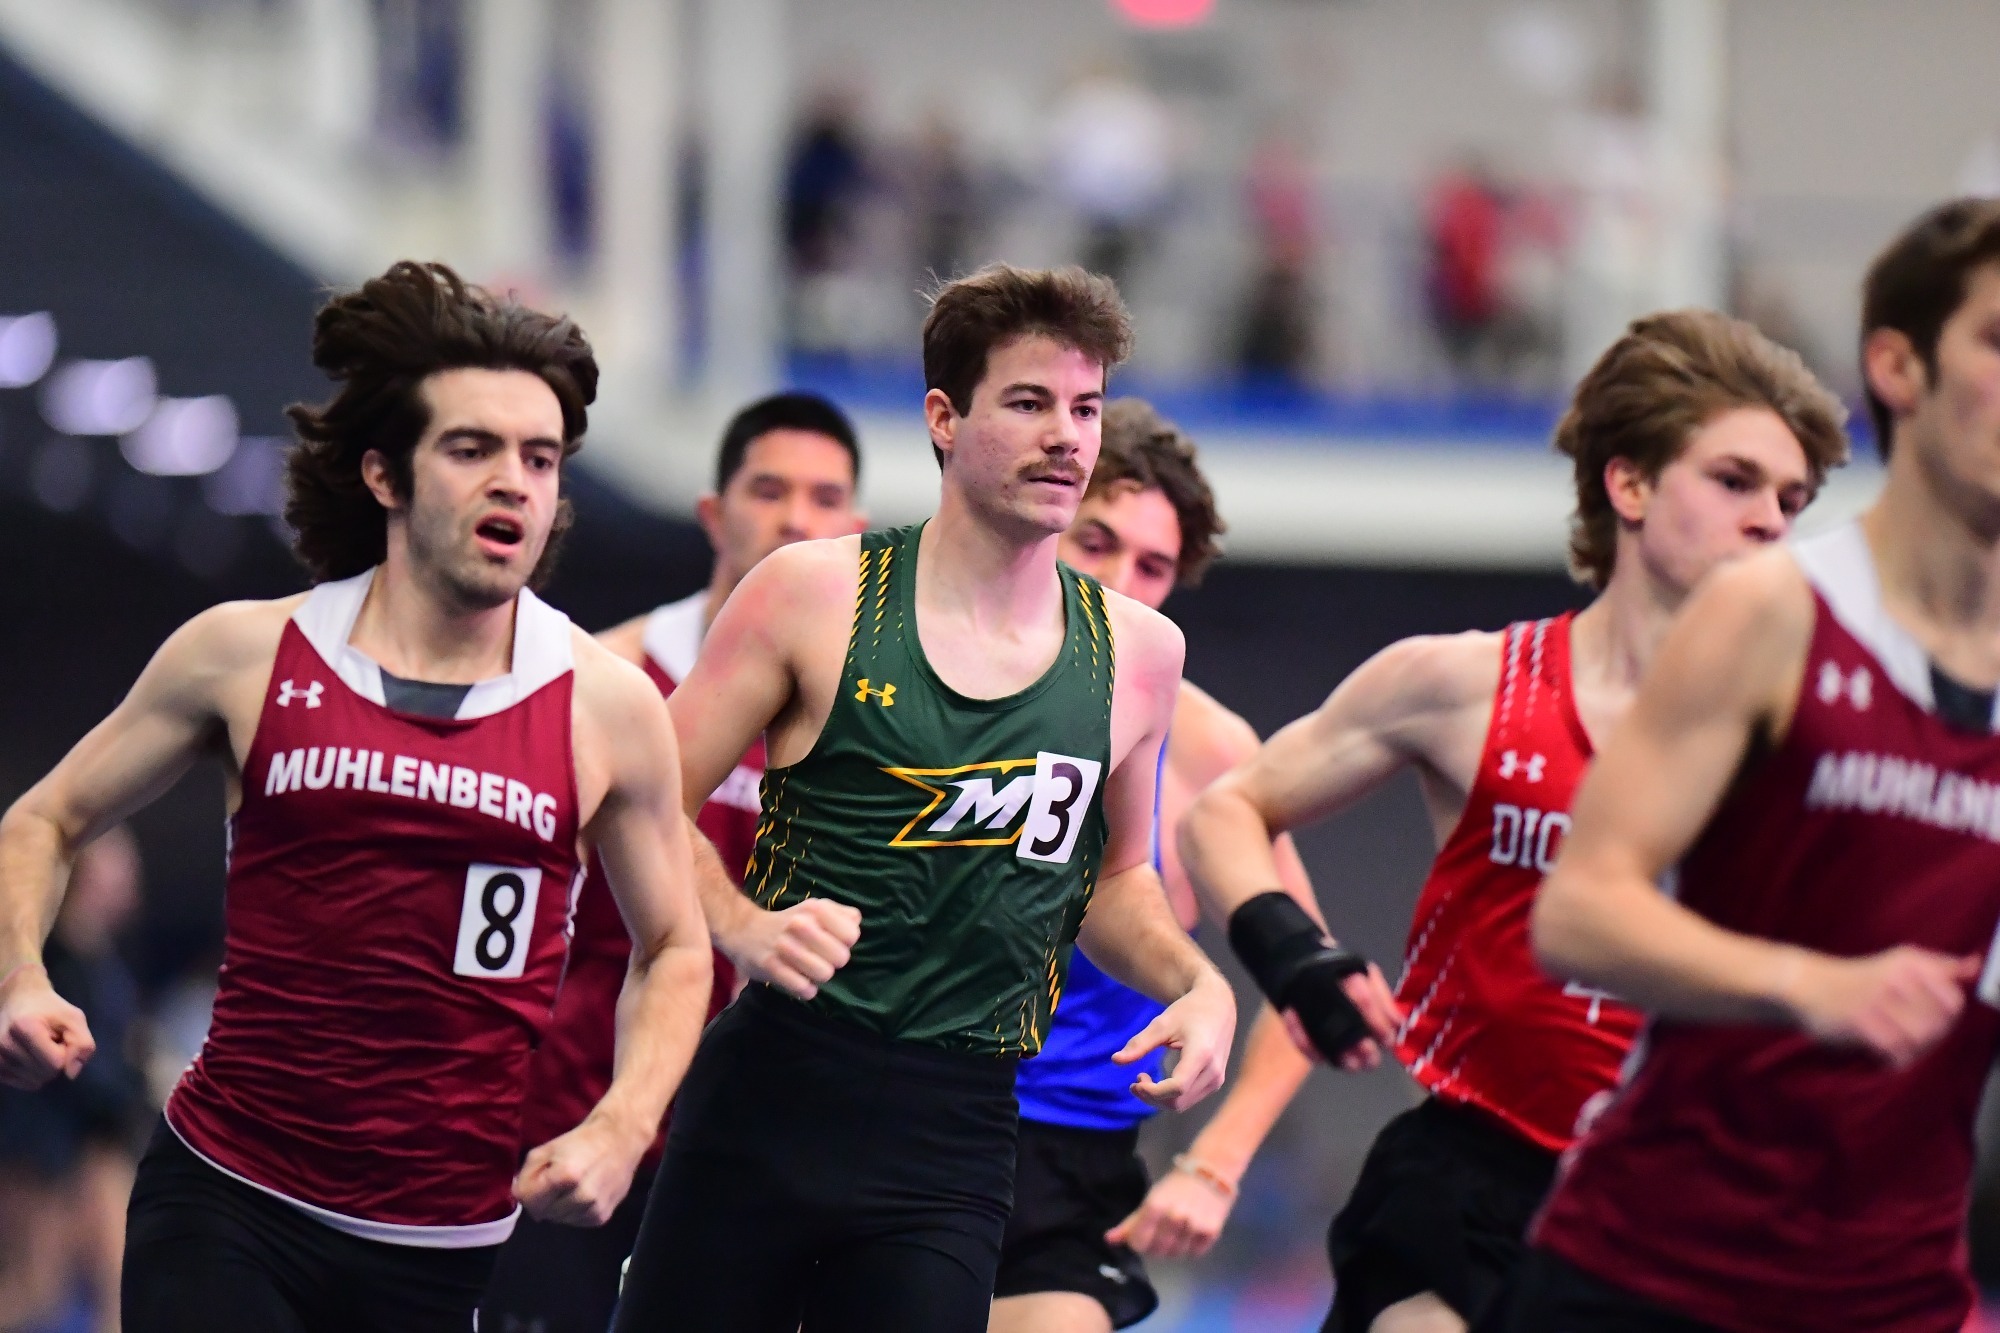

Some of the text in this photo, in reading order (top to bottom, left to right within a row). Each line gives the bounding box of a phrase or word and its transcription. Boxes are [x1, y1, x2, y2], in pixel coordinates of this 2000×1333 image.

[266, 748, 557, 842] MUHLENBERG
[1030, 763, 1083, 856] 3
[475, 873, 525, 971] 8
